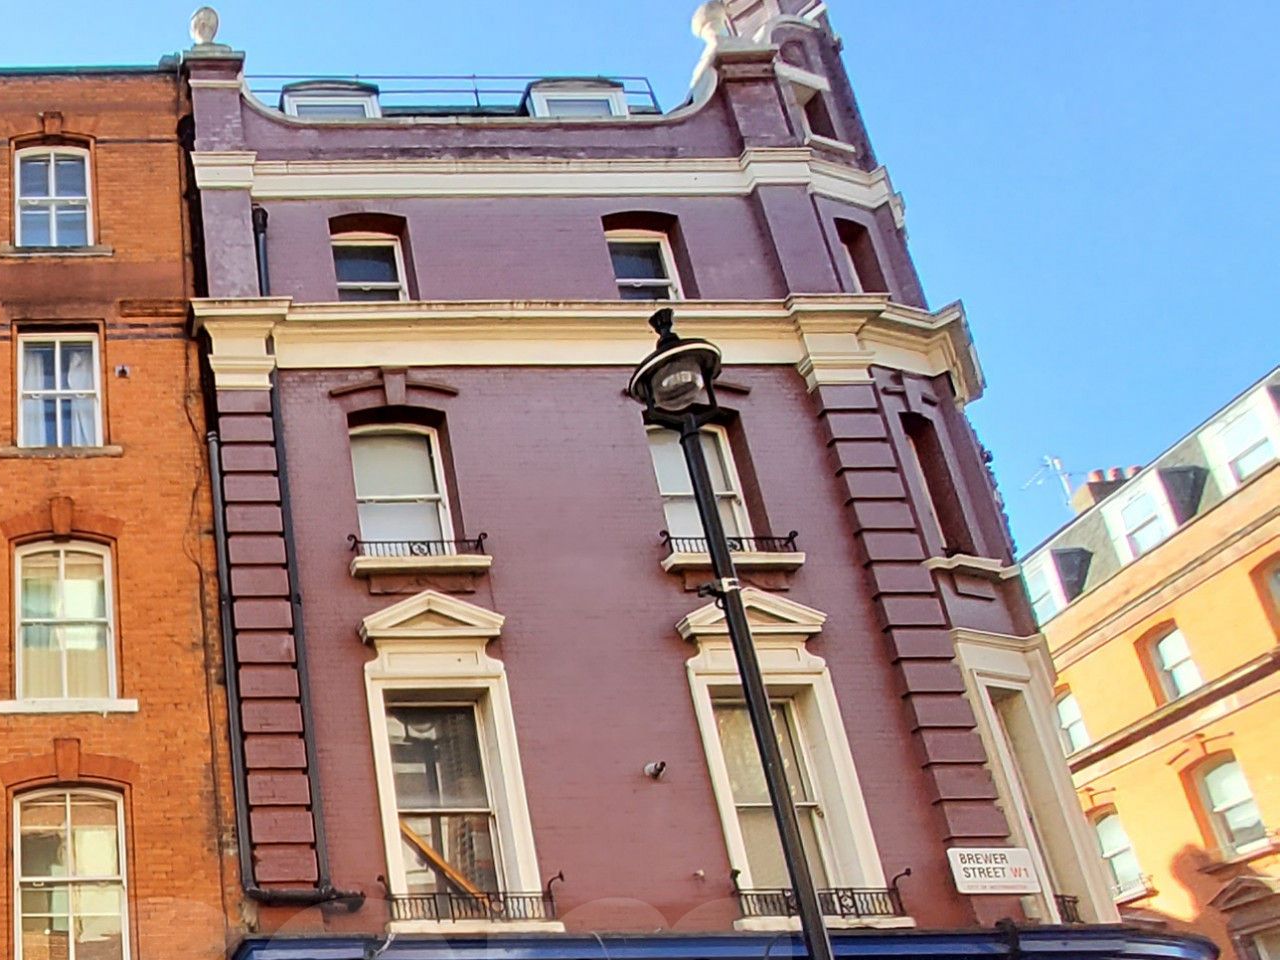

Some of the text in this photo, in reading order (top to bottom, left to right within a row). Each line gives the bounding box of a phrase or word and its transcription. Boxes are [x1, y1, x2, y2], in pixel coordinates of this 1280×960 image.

[959, 852, 1008, 865] BREWER
[962, 866, 1030, 879] STREET W1
